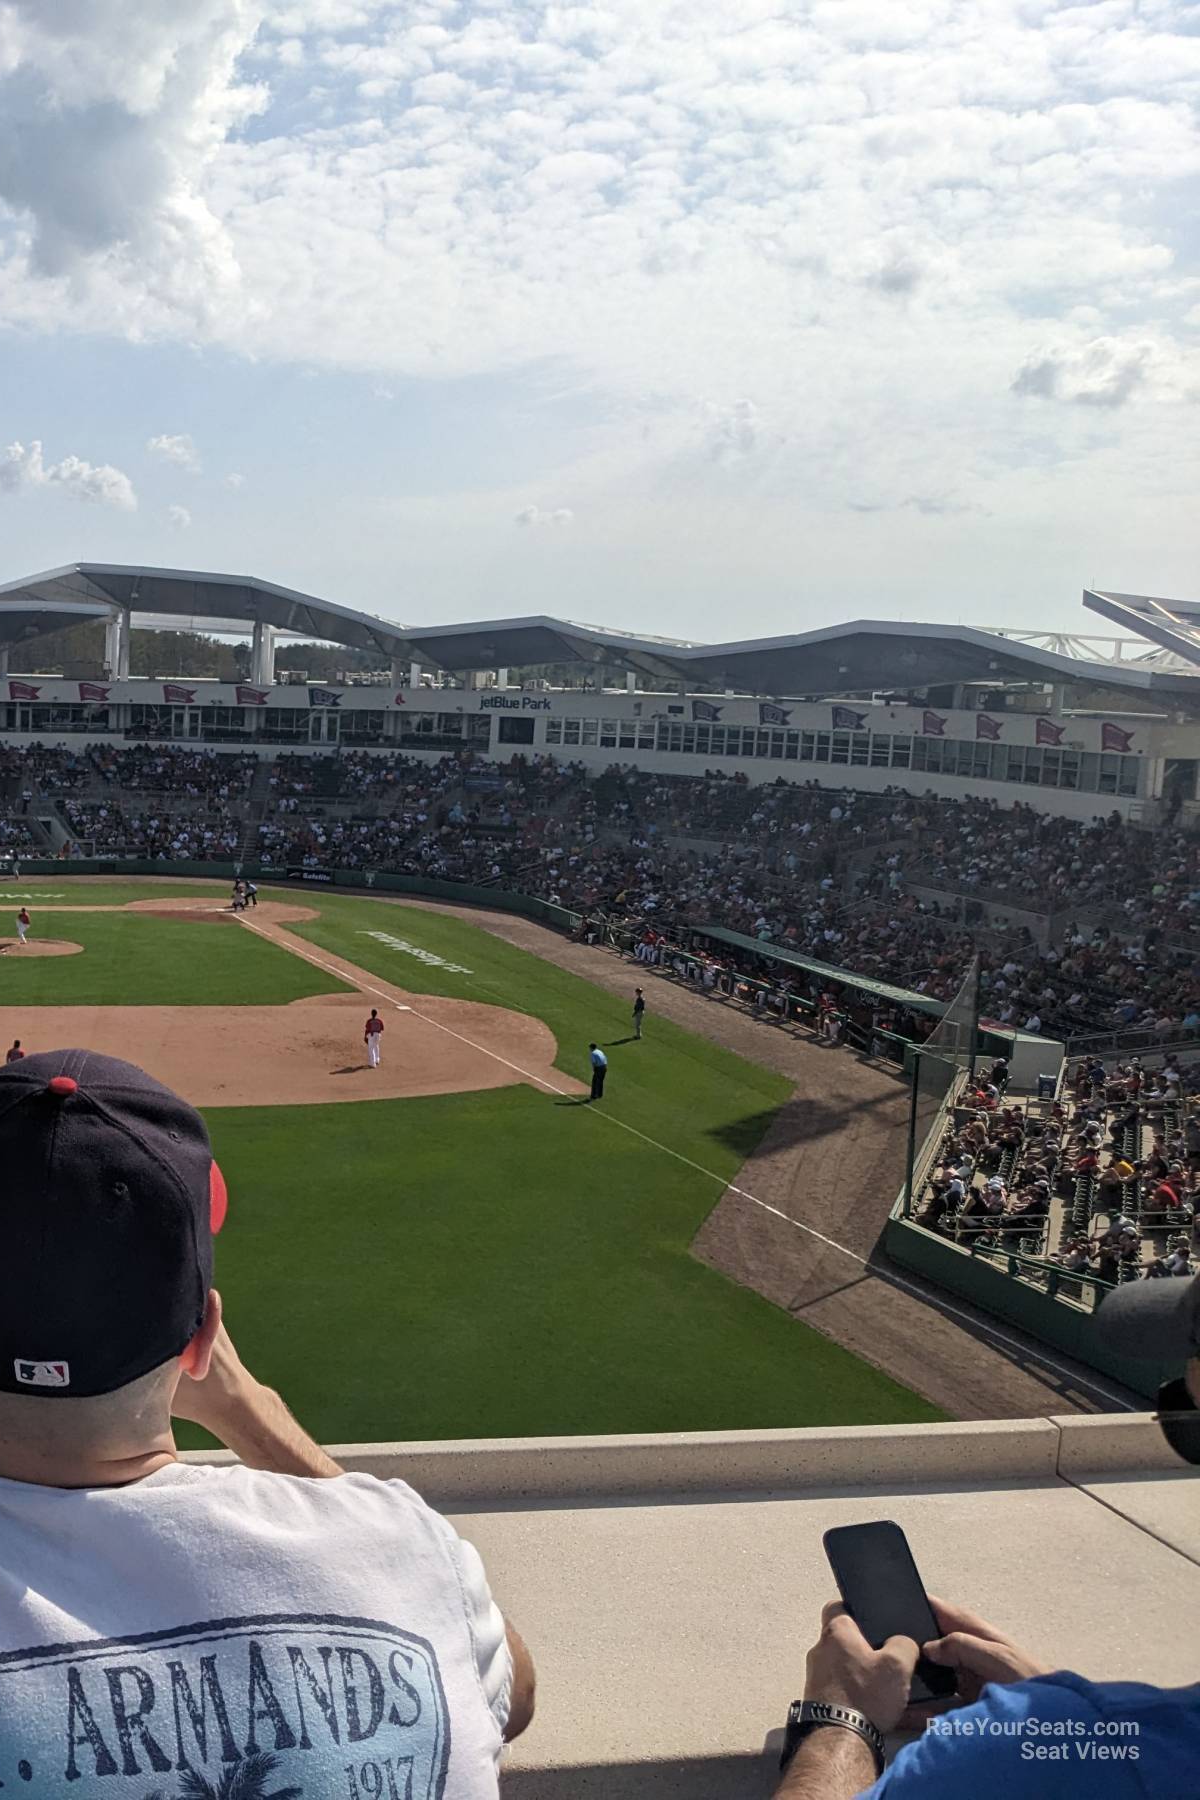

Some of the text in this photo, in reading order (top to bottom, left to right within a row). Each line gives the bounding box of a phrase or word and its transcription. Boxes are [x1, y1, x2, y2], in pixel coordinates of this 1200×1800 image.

[480, 695, 551, 710] jetBlue Park
[64, 1641, 422, 1781] ARMANDS
[344, 1755, 414, 1800] 1917
